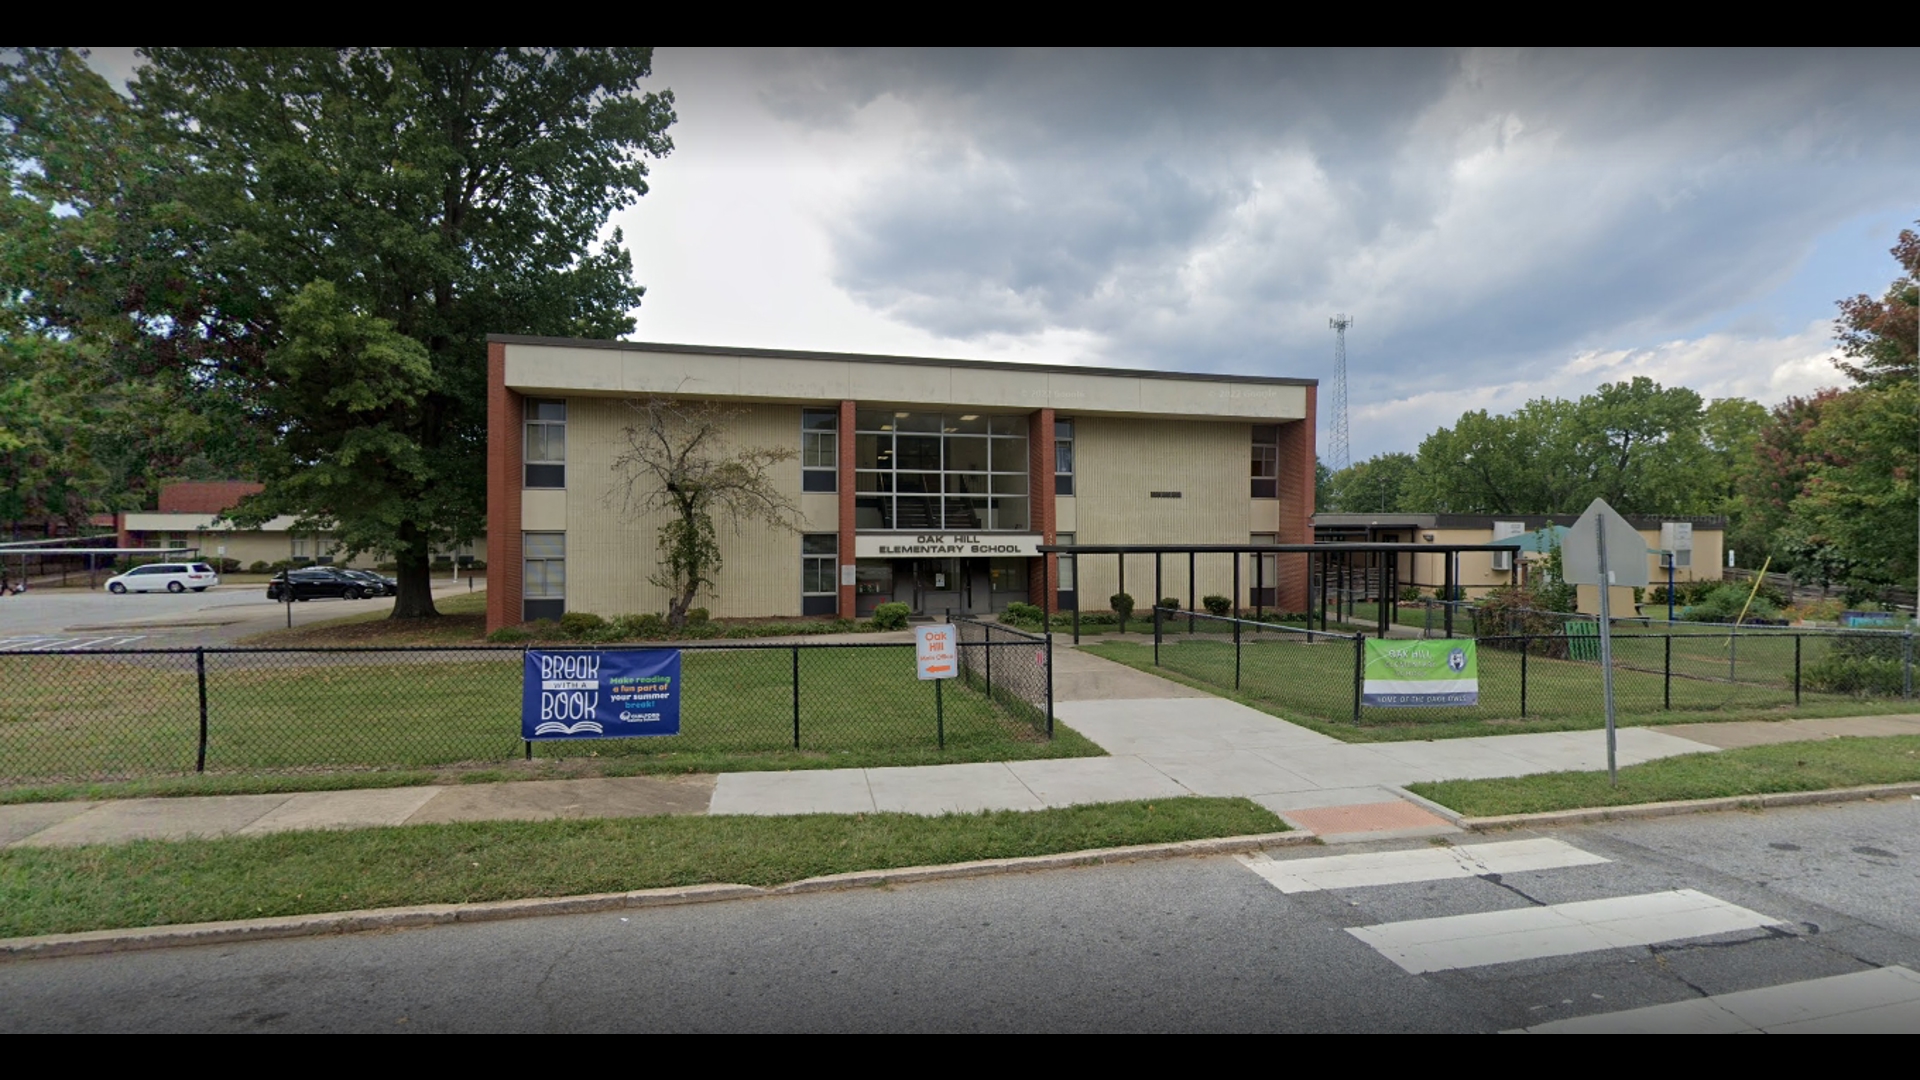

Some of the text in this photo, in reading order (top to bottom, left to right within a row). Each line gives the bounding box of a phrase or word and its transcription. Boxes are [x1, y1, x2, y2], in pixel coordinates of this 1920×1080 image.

[917, 535, 980, 544] OAK HILL
[879, 545, 1021, 554] ELEMENTARY SCHOOL
[925, 631, 947, 641] Oak
[929, 642, 944, 652] Hill
[610, 675, 671, 685] Make reading
[637, 684, 658, 693] part
[658, 683, 668, 691] of
[610, 693, 670, 703] your summer
[541, 692, 598, 720] BOOK
[625, 700, 655, 709] break!
